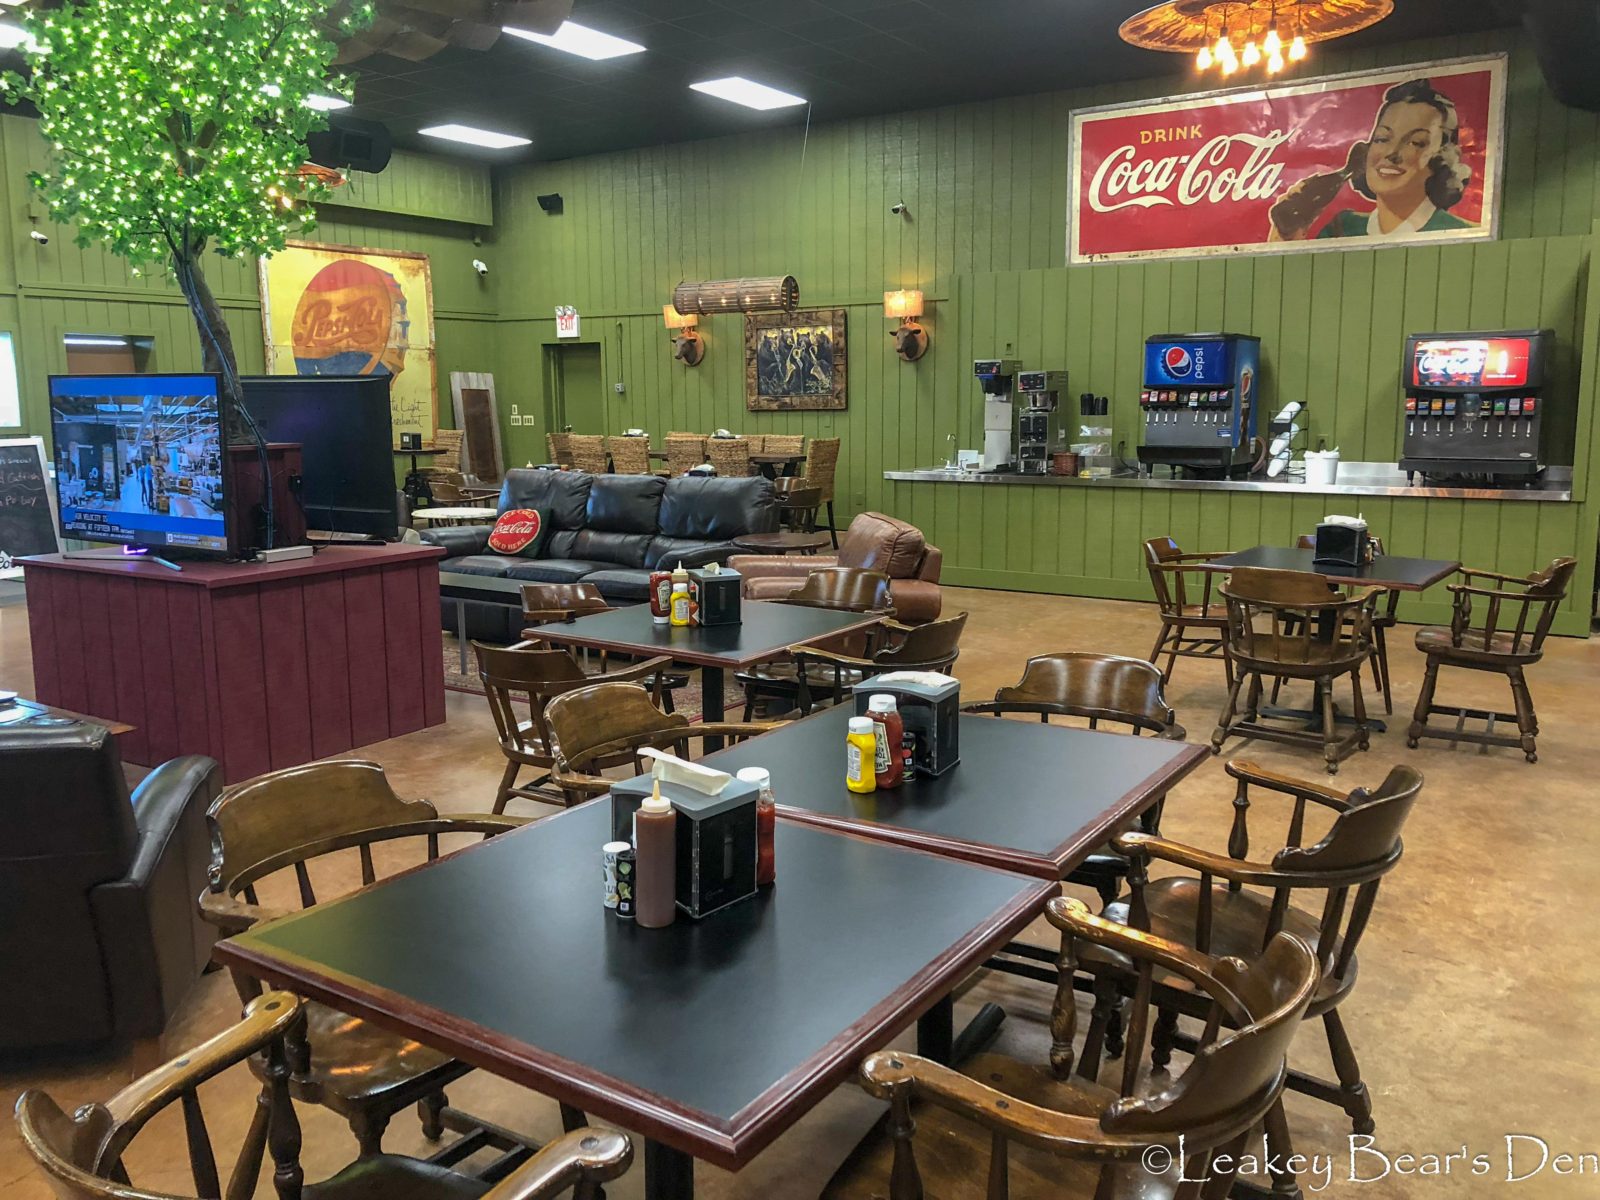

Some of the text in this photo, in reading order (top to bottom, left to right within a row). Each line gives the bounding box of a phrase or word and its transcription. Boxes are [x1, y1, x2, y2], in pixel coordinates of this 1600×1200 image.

[1140, 124, 1203, 144] DRINK
[1088, 127, 1299, 213] Coca-Cola
[560, 315, 574, 331] EXIT
[1194, 346, 1206, 379] pepsi
